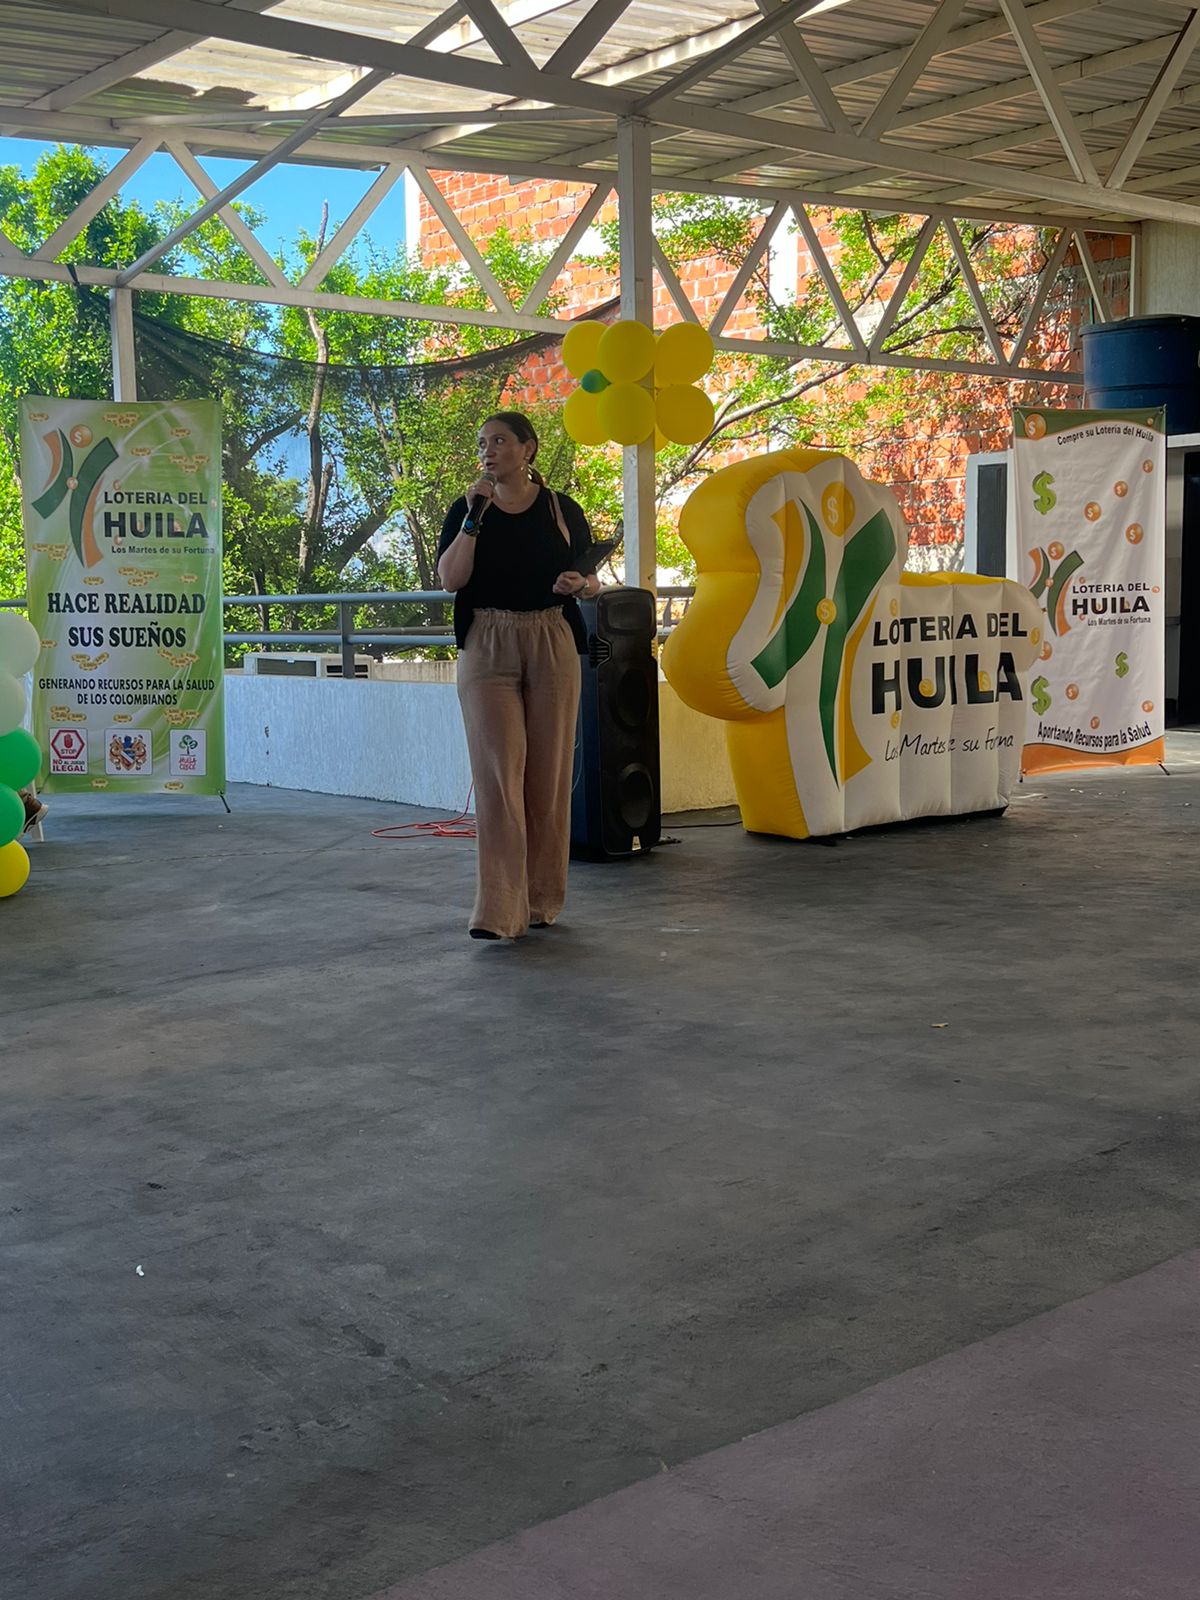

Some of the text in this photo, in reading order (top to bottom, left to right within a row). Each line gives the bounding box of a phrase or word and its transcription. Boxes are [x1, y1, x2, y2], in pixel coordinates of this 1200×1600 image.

[1057, 431, 1083, 445] Compre
[1086, 428, 1094, 437] su
[1123, 426, 1134, 435] del
[1136, 428, 1154, 442] Huila
[104, 491, 208, 505] LOTERIA DEL
[104, 511, 208, 538] HUILA
[111, 545, 126, 554] Los
[128, 546, 157, 554] Martes
[159, 546, 169, 554] de
[184, 546, 215, 554] Fortuna
[1072, 582, 1150, 594] LOTERIA DEL
[47, 592, 206, 614] HACE REALIDAD
[1072, 595, 1150, 616] HUILA
[873, 612, 1028, 647] LOTERIA DEL
[1087, 618, 1097, 627] Los
[1098, 617, 1117, 625] Martes
[1130, 616, 1151, 624] Fortuna
[68, 621, 186, 648] SUS SUEÑOS
[39, 678, 215, 691] GENERANDO RECURSOS PARA LA SALUD
[872, 652, 1023, 715] HUILA
[77, 693, 177, 705] DE LOS COLOMBIANOS
[899, 734, 946, 756] Martes
[962, 739, 980, 752] su
[1037, 721, 1152, 750] Aportando Recursos para la Salud
